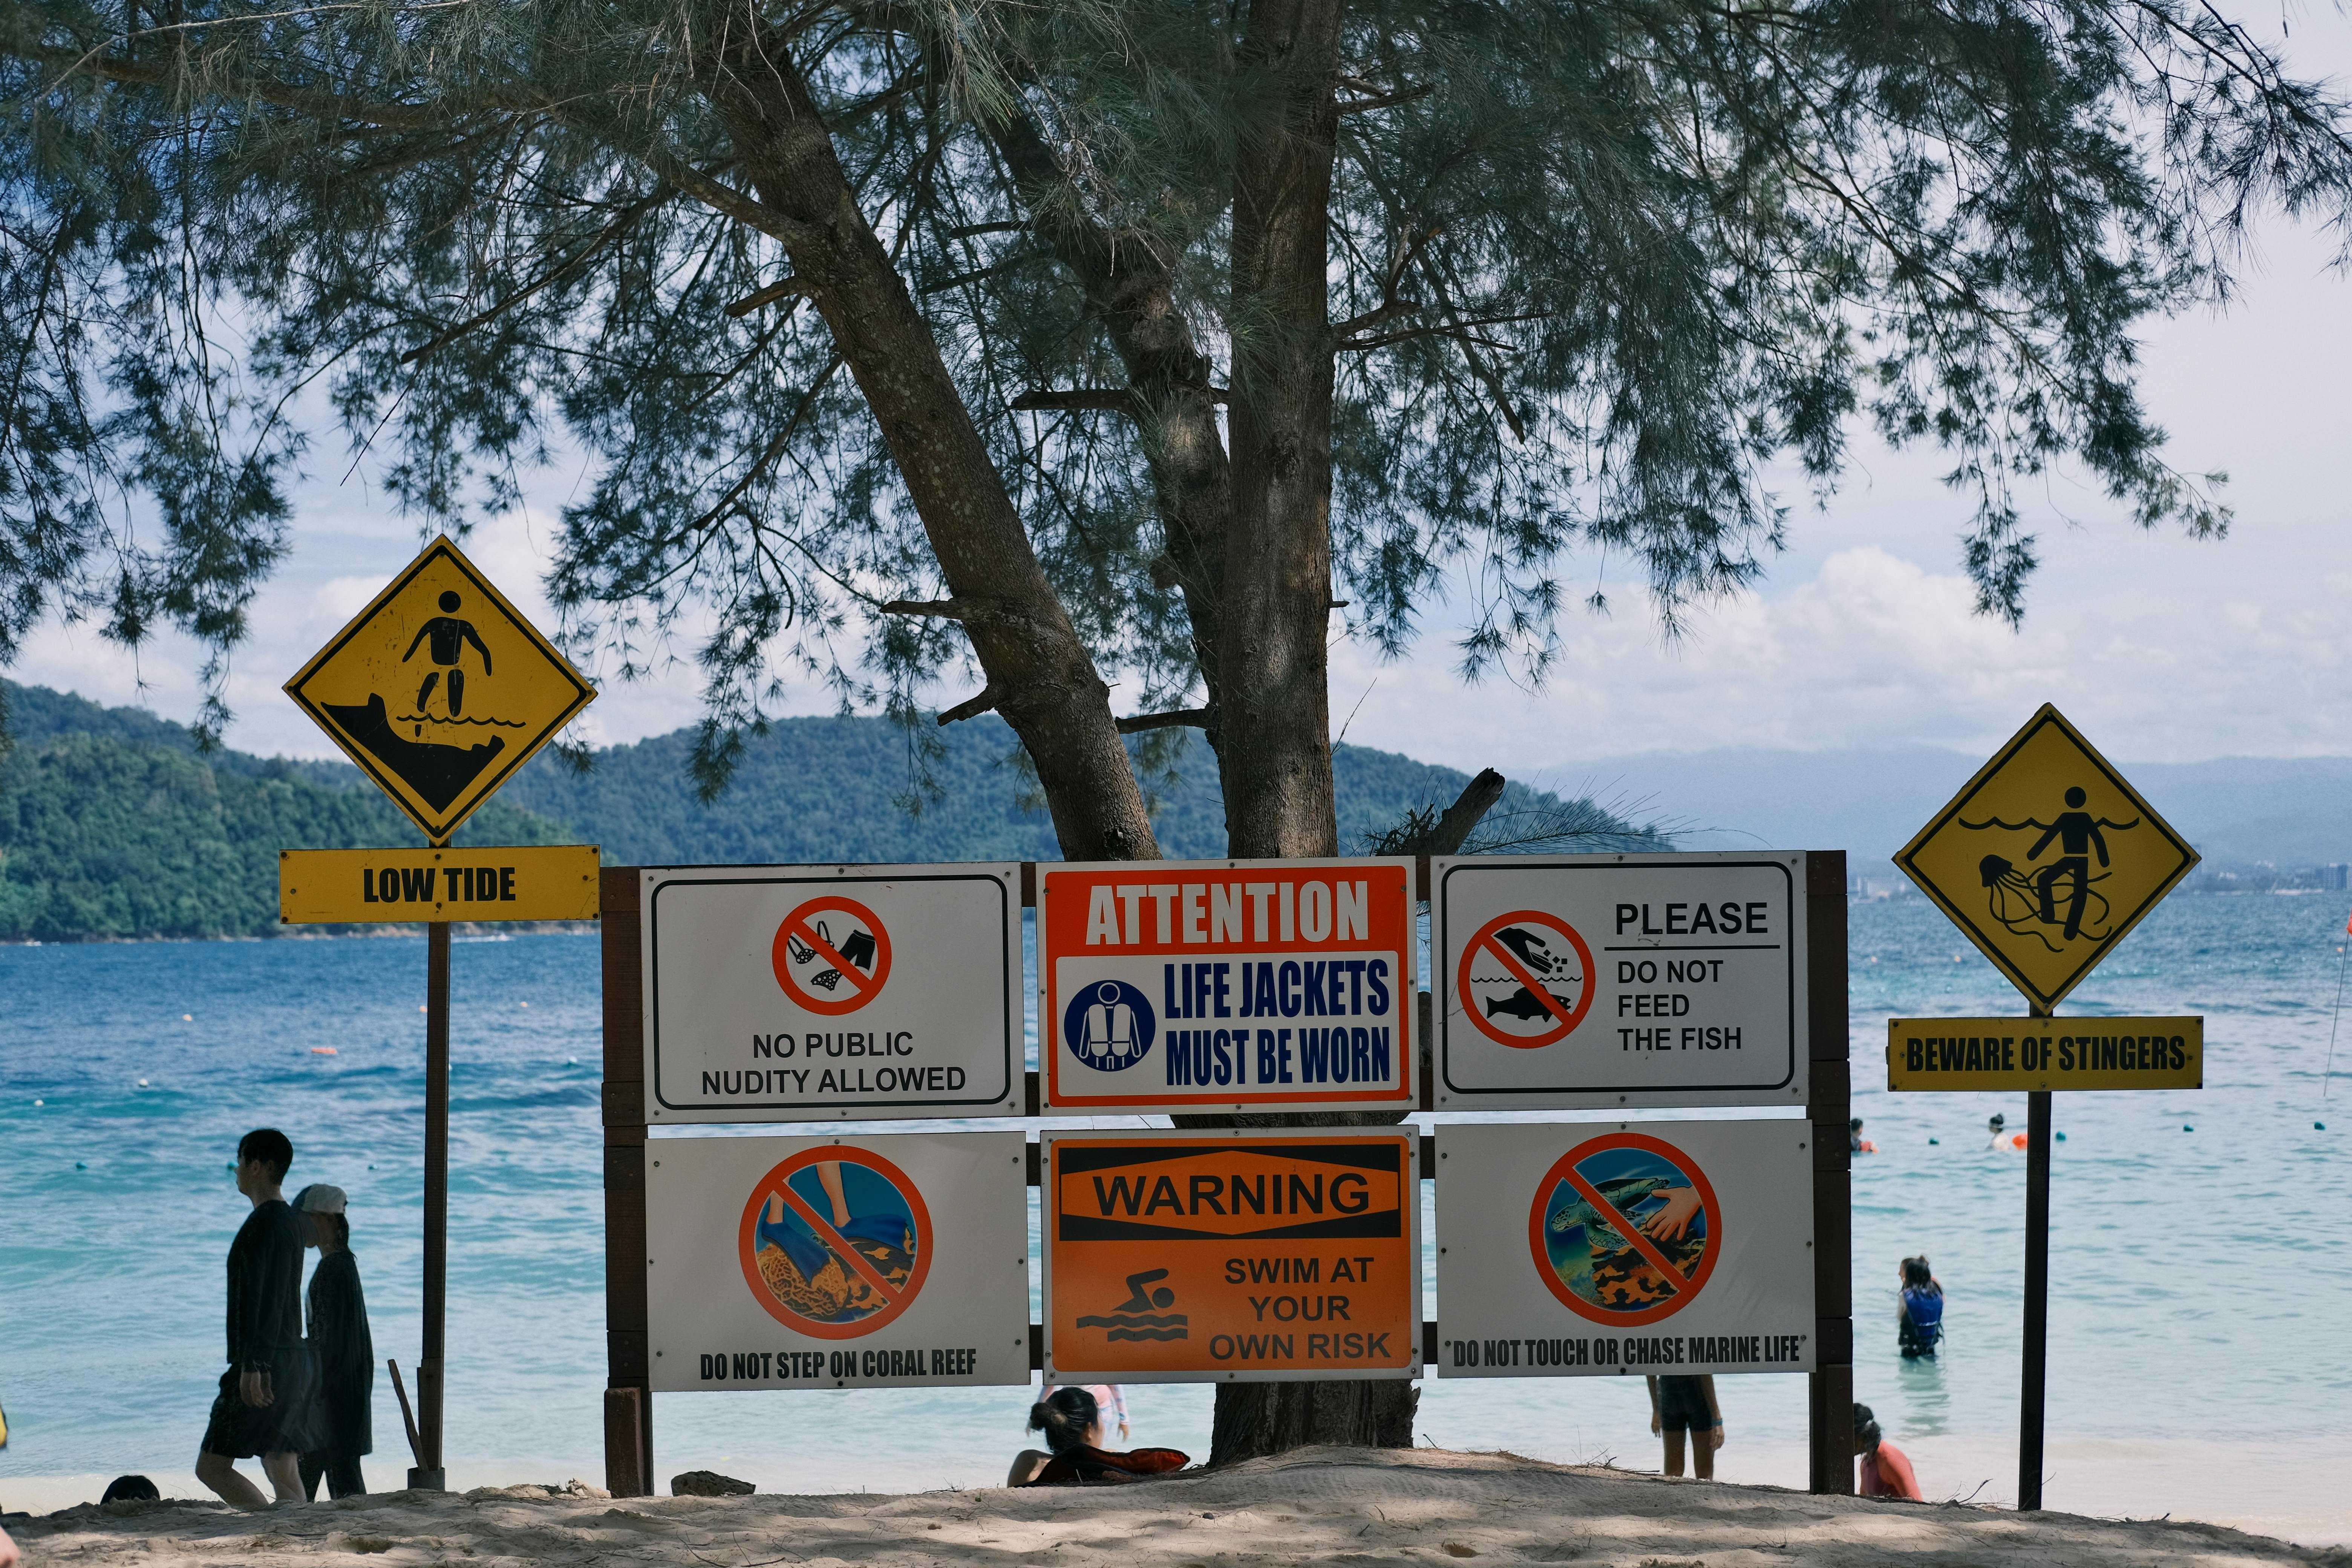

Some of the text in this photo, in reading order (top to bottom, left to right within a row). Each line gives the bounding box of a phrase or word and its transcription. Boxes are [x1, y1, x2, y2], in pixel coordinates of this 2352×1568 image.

[364, 867, 516, 903] LOW TIDE
[1086, 880, 1368, 945] ATTENTION
[1616, 902, 1768, 935] PLEASE
[1618, 959, 1724, 984] DO NOT
[1165, 959, 1389, 1018] LIFE JACKETS
[1619, 994, 1689, 1017] FEED
[753, 1032, 913, 1058] NO PUBLIC
[1617, 1026, 1741, 1051] THE FISH
[1907, 1035, 2185, 1071] BEWARE OF STINGERS
[1166, 1026, 1390, 1086] MUST BE WORN
[703, 1067, 966, 1095] NUDITY ALLOWED
[1092, 1173, 1369, 1216] WARNING
[1225, 1257, 1374, 1284] SWIM AT
[1248, 1295, 1351, 1322] YOUR
[1210, 1332, 1390, 1360] OWN RISK
[1453, 1335, 1799, 1367] DO NOT TOUCH OR CHASE MARINE LIFE
[700, 1349, 976, 1380] DO NOT STEP ON CORAL REEF
